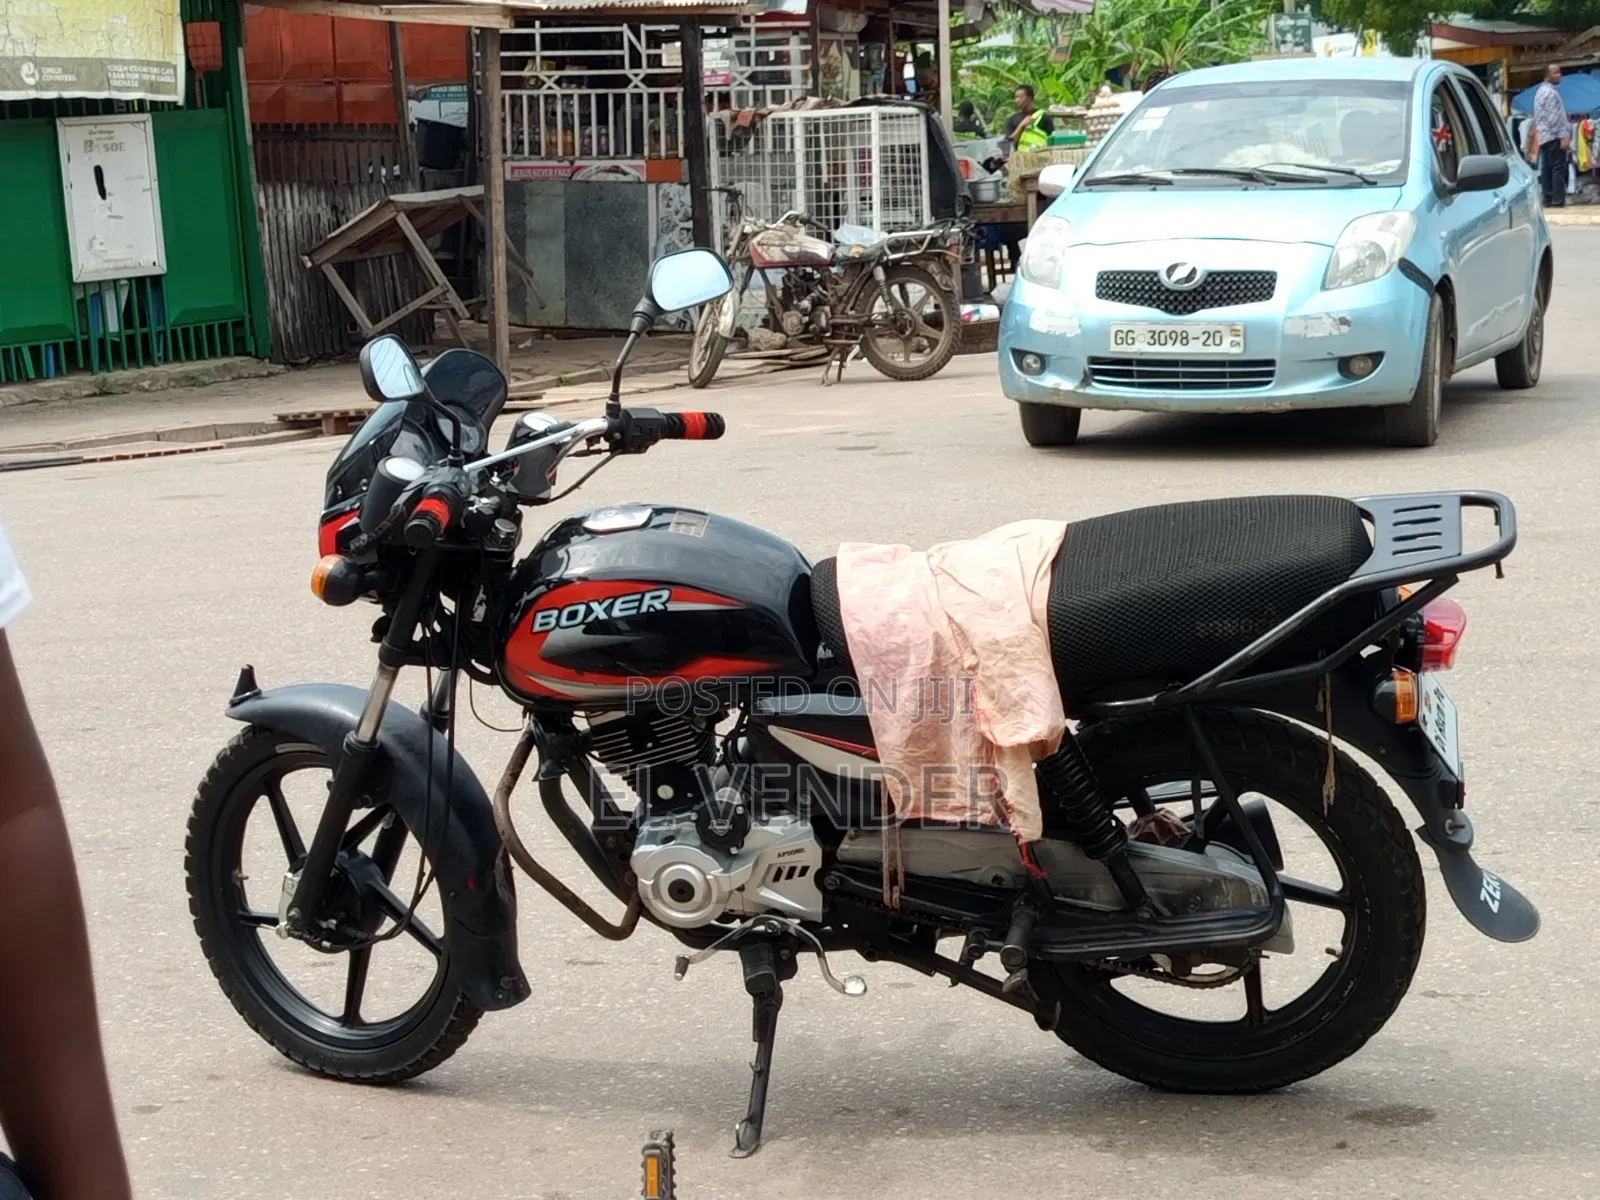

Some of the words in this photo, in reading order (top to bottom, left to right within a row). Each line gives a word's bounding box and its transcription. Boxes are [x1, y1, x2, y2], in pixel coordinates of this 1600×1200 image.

[42, 74, 77, 82] COUNTERS
[1114, 329, 1136, 346] GG
[1147, 330, 1223, 347] 3098-20
[532, 588, 671, 634] BOXER
